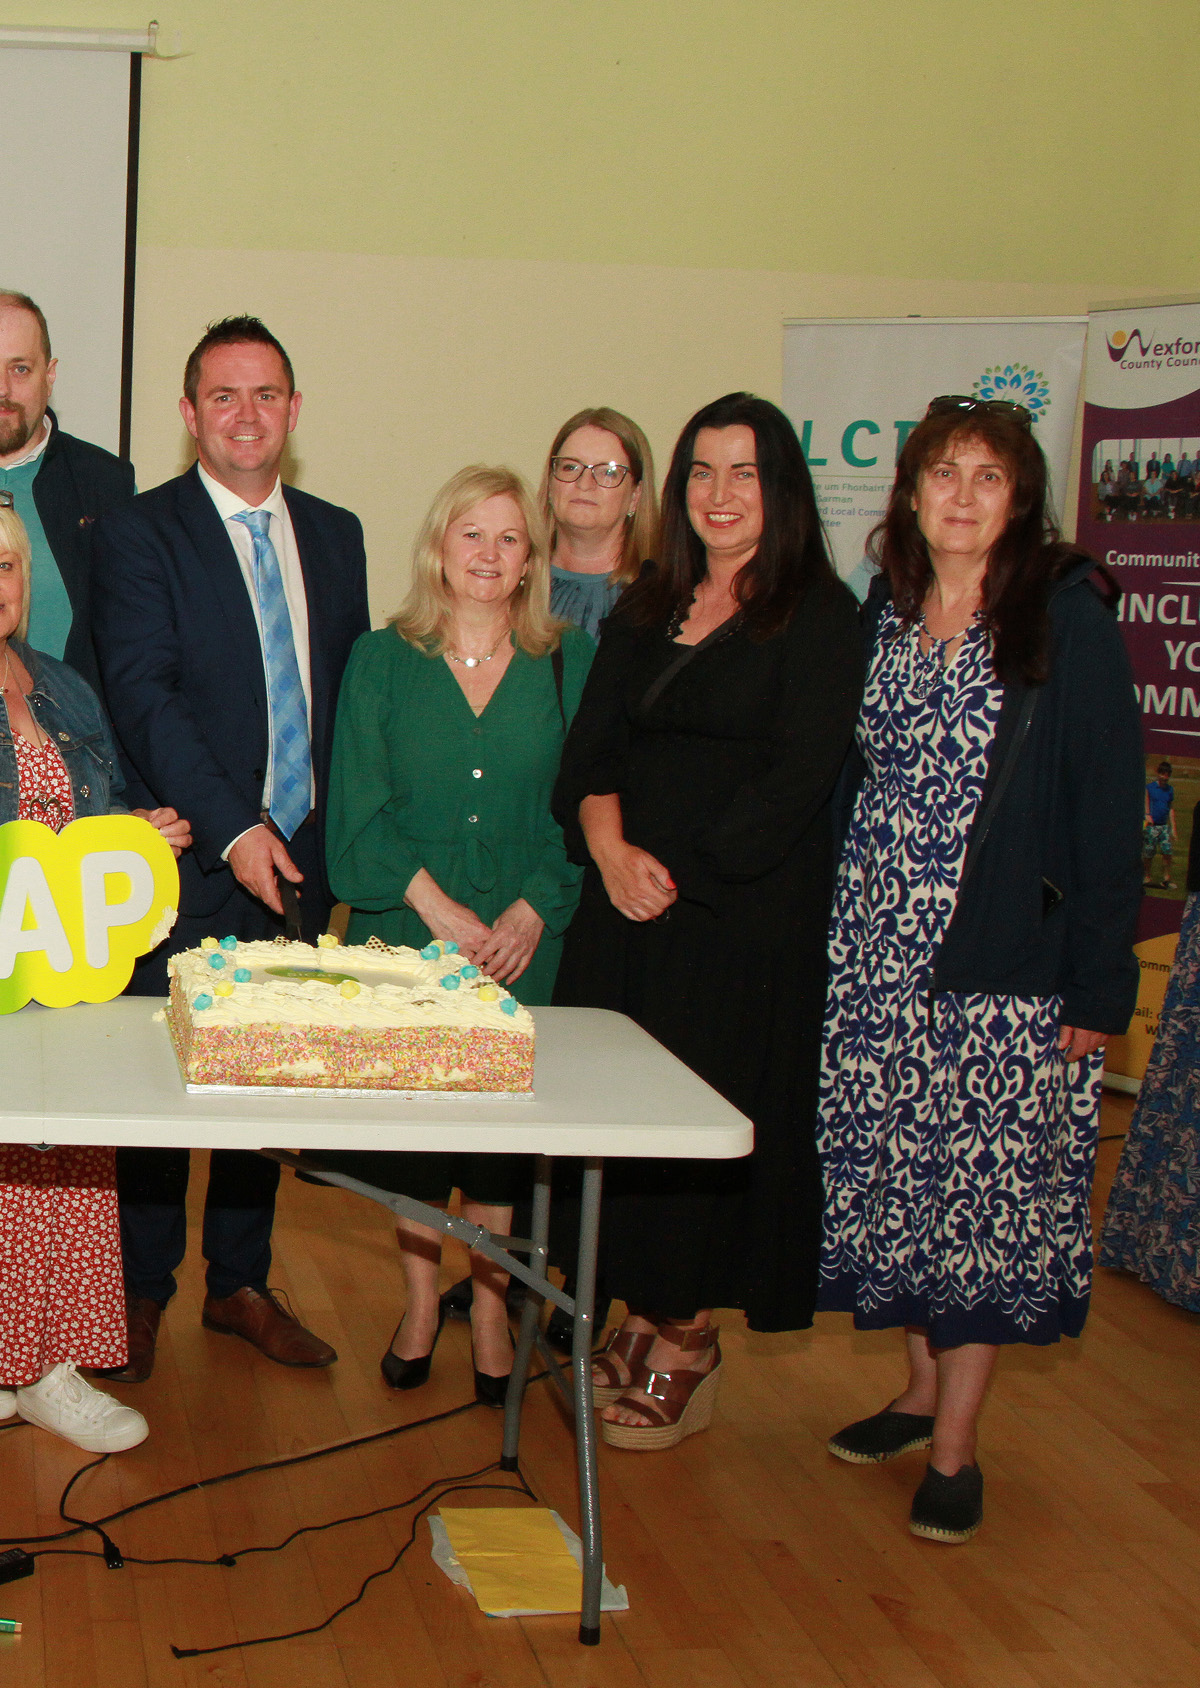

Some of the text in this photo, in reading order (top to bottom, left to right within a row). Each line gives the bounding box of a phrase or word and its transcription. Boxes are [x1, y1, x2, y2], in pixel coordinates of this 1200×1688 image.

[1121, 357, 1200, 370] County Coun
[831, 508, 855, 516] Local
[1117, 593, 1200, 625] INCL
